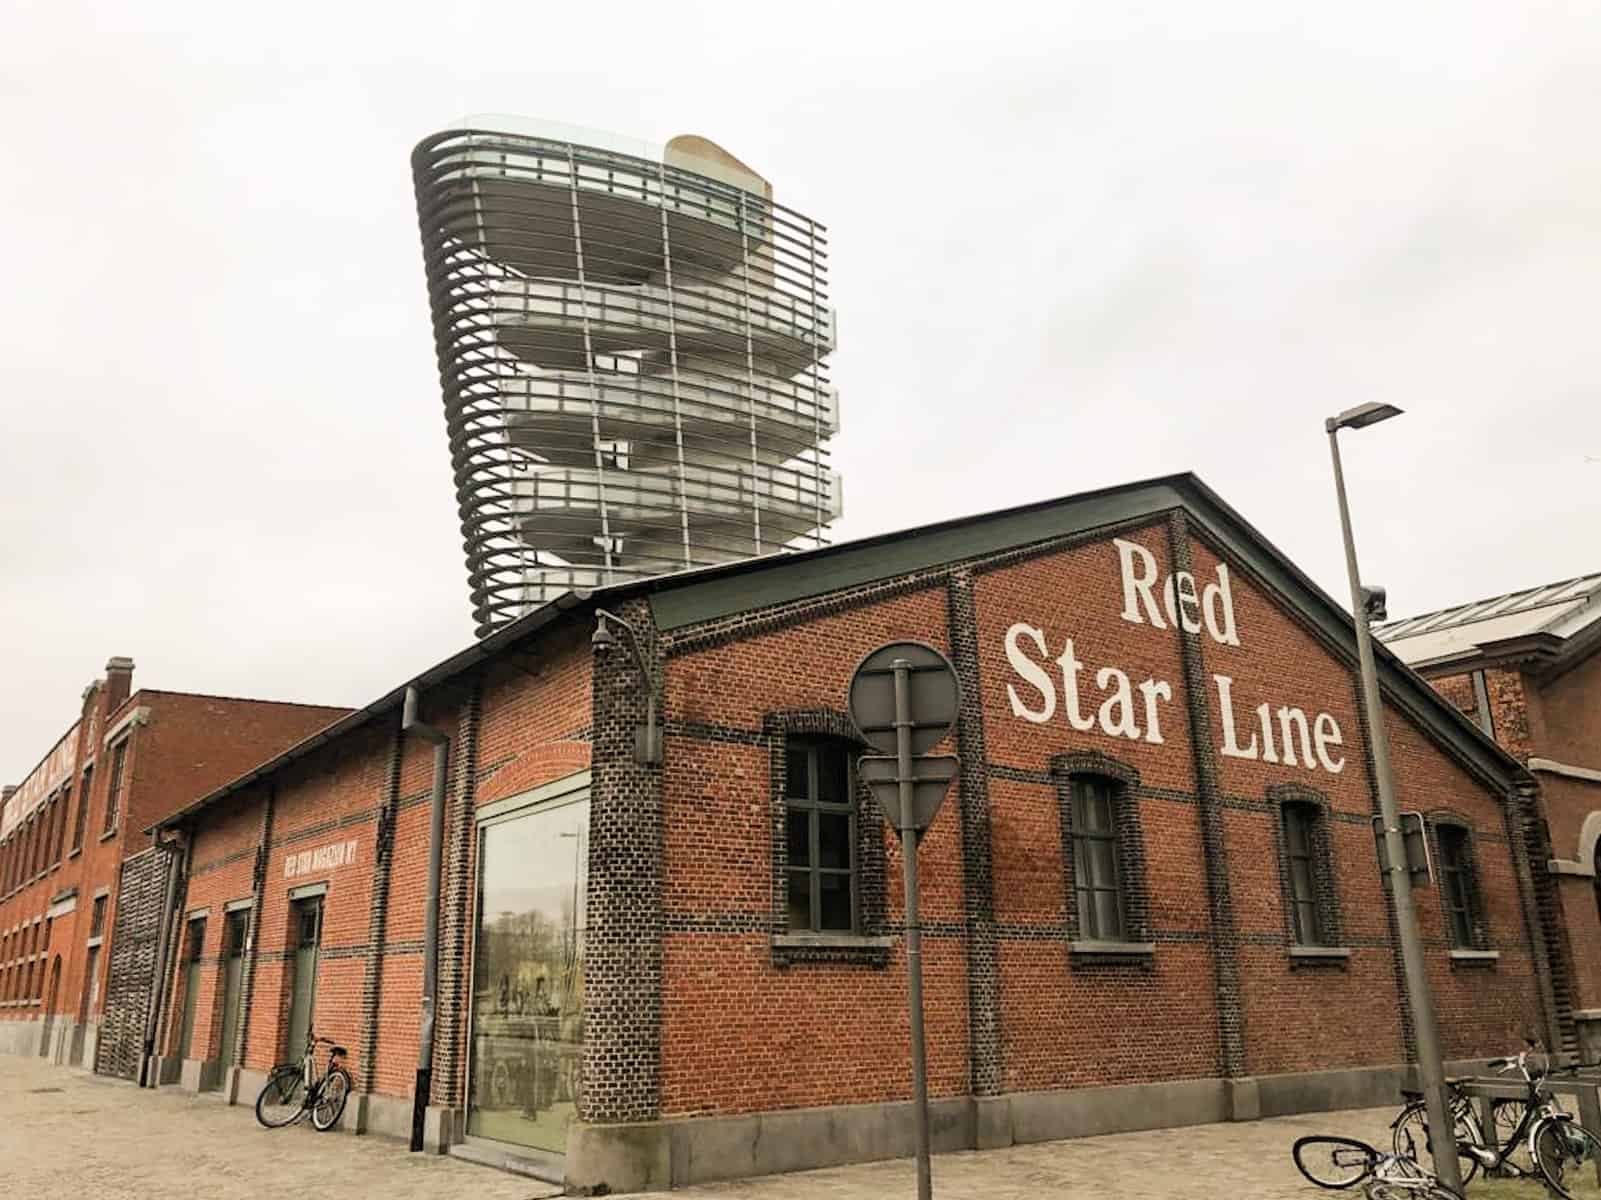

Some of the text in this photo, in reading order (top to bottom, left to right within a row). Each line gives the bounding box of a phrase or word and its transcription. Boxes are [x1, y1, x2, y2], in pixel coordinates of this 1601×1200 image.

[1113, 537, 1241, 647] Red
[1004, 622, 1346, 774] Star Line
